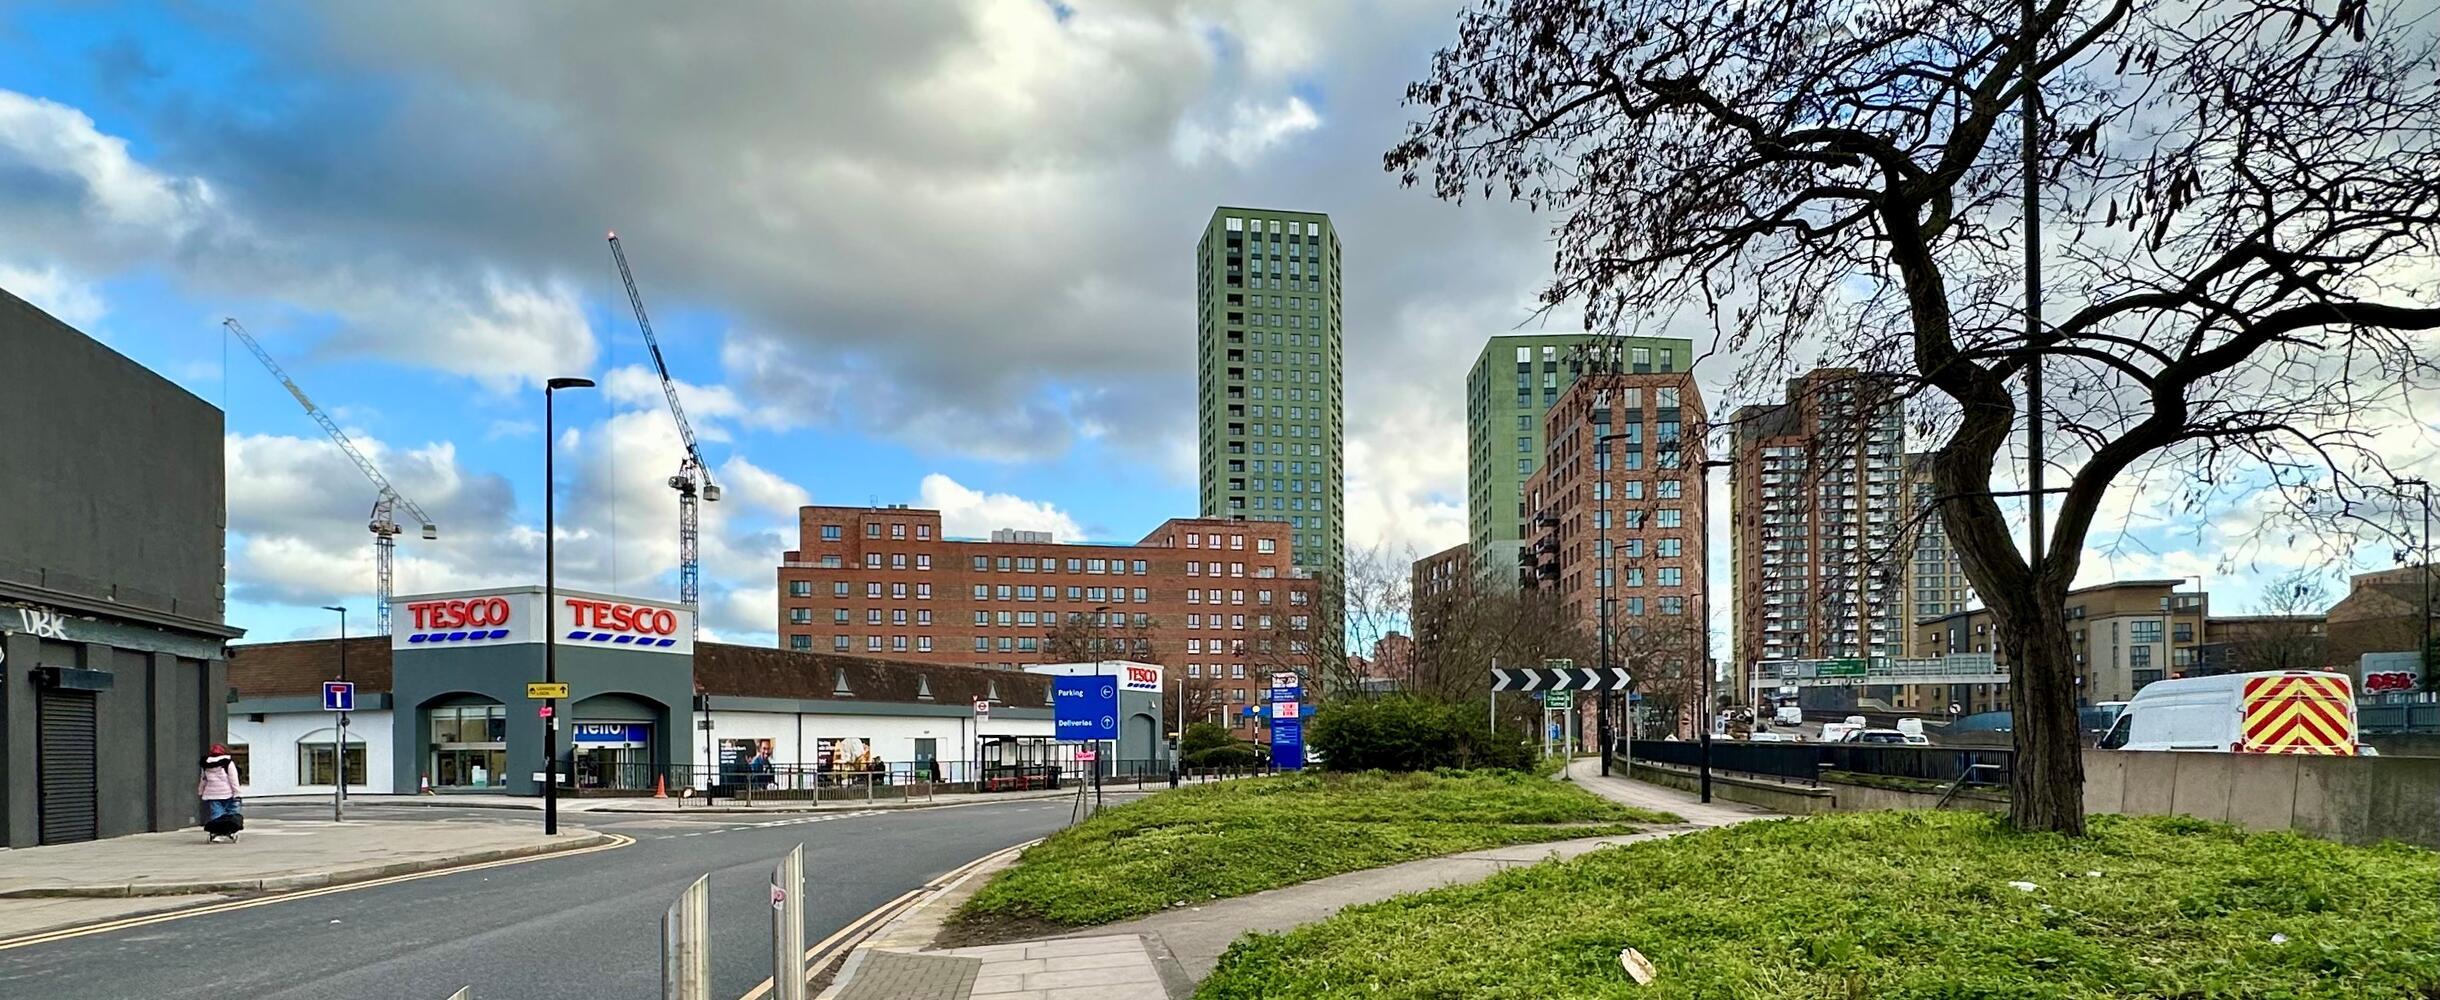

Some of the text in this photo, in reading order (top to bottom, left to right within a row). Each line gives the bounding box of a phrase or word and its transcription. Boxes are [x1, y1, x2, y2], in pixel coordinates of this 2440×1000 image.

[408, 597, 509, 629] TESCO
[566, 599, 677, 635] TESCO
[1127, 667, 1157, 683] TESCO
[1058, 689, 1084, 698] Parking
[1058, 719, 1093, 727] Deliveries
